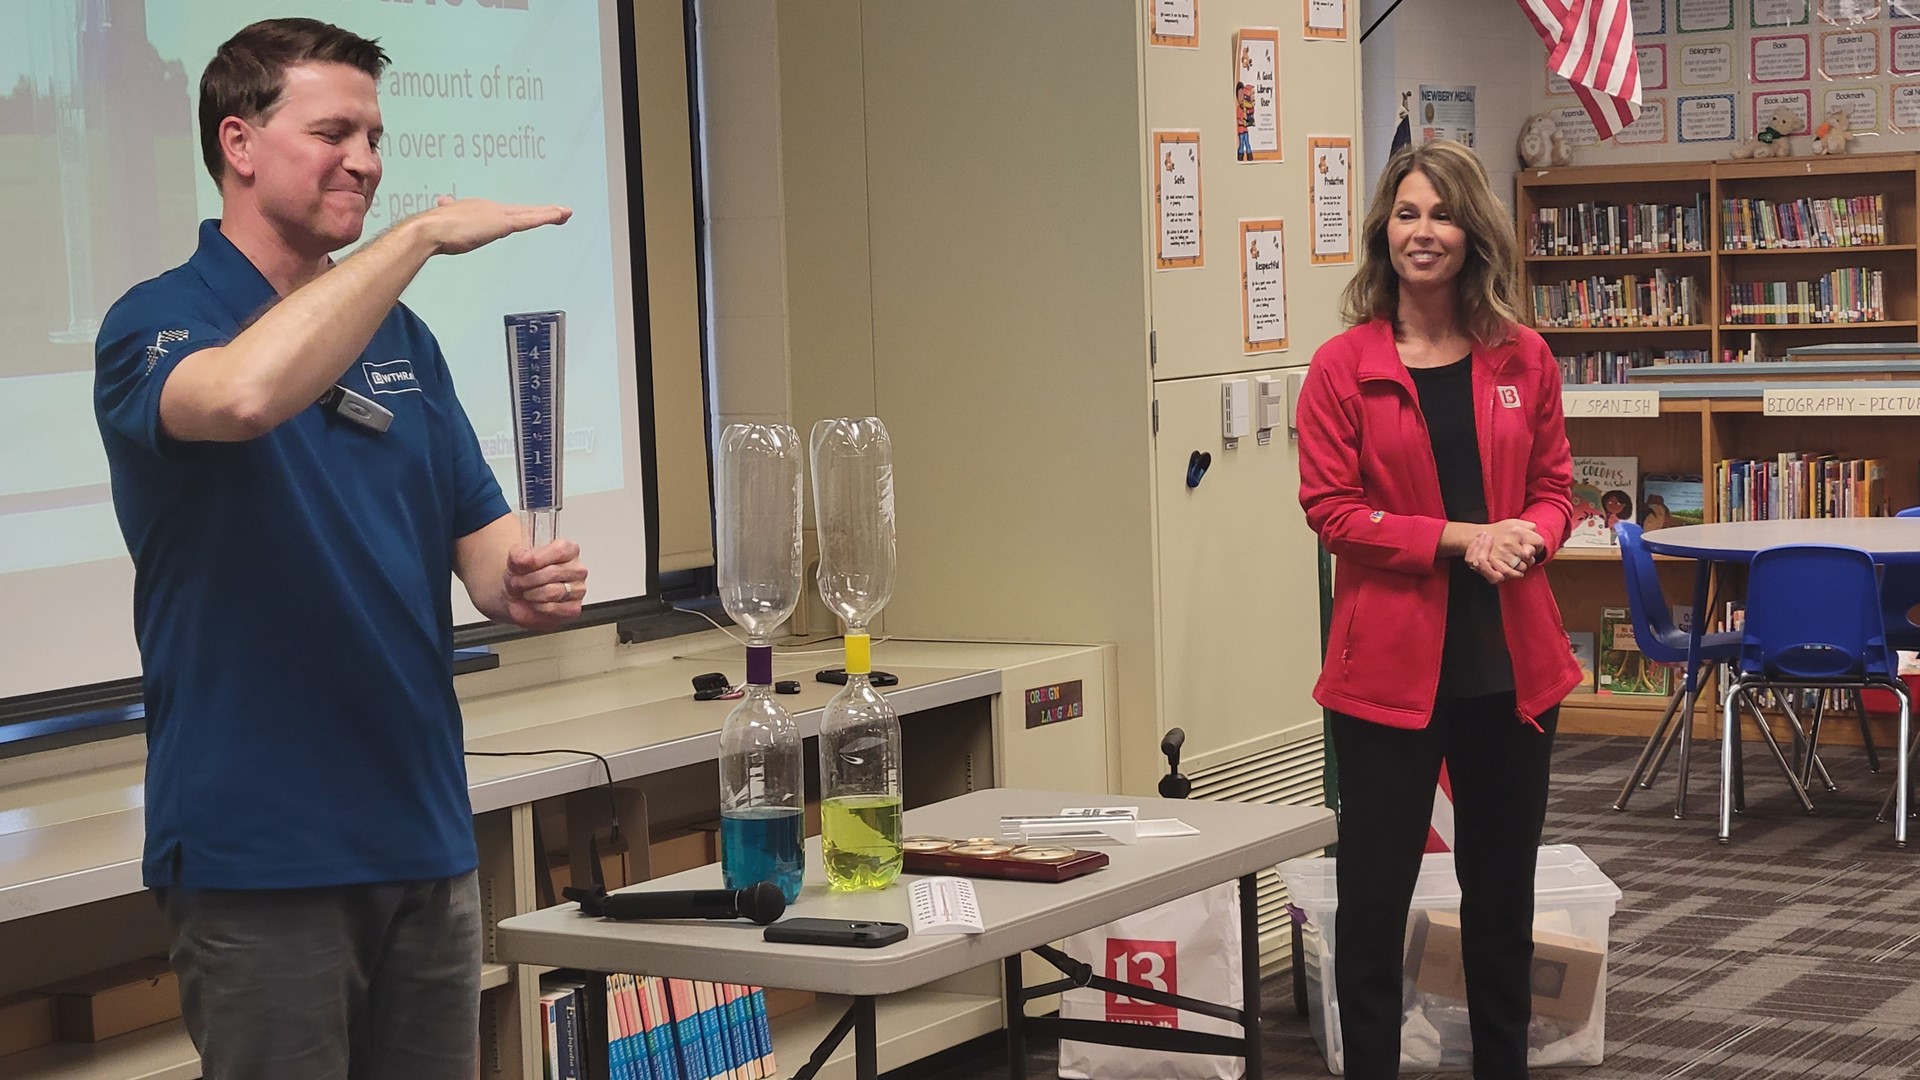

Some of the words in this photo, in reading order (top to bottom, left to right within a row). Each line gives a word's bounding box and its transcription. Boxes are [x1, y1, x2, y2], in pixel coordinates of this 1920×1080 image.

[1837, 36, 1862, 44] Bookend
[1689, 46, 1722, 55] Bibliography
[390, 68, 473, 98] amount
[480, 64, 501, 99] of
[506, 68, 544, 100] rain
[1257, 71, 1261, 81] A
[1262, 71, 1273, 81] Good
[1257, 84, 1273, 98] Library
[1421, 90, 1454, 102] NEWBERY
[1455, 91, 1474, 102] MEDAL
[1836, 92, 1865, 100] Bookmark
[1261, 98, 1270, 107] User
[1764, 97, 1779, 105] Book
[1780, 96, 1799, 104] Jacket
[1562, 110, 1585, 118] Appendix
[399, 131, 447, 158] over
[454, 135, 465, 158] a
[472, 125, 546, 166] specific
[1174, 175, 1185, 185] Safe
[1324, 176, 1344, 186] Productive
[1255, 260, 1279, 275] Respectful
[528, 320, 539, 334] 5
[528, 346, 540, 360] 4
[531, 375, 541, 390] 3
[1502, 389, 1516, 404] 13
[1587, 400, 1651, 417] SPANISH
[1767, 397, 1855, 413] BIOGRAPHY
[532, 411, 542, 425] 2
[533, 451, 543, 465] 1
[1582, 465, 1624, 479] COLORES
[1113, 951, 1168, 1006] 13
